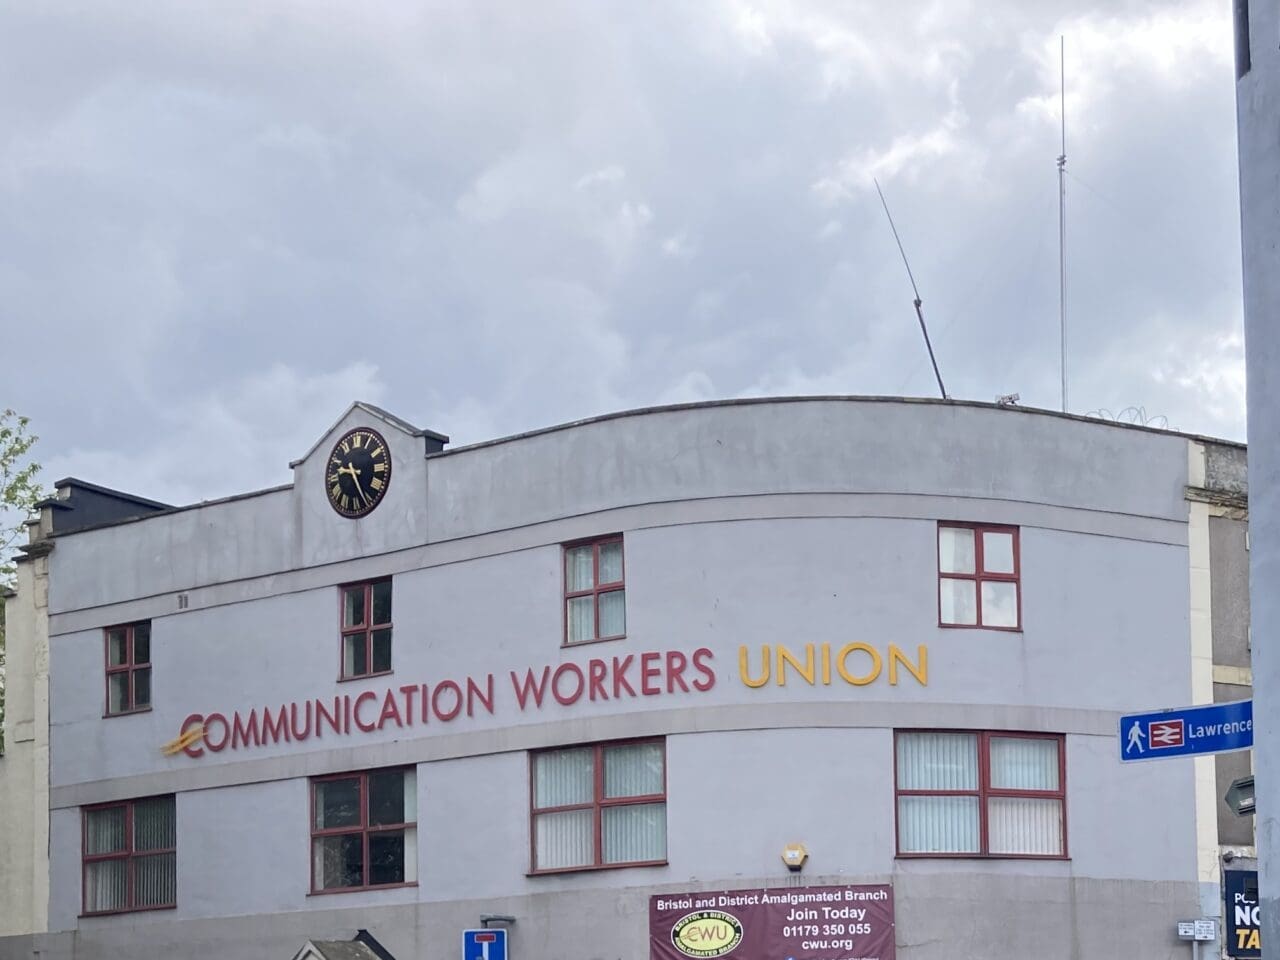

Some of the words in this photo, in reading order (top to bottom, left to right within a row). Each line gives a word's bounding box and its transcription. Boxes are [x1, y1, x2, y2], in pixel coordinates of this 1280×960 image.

[180, 673, 496, 758] COMMUNICATION
[510, 647, 716, 714] WORKERS
[738, 642, 929, 689] UNION
[1188, 718, 1253, 739] Lawrence
[657, 898, 692, 910] Bristol
[695, 897, 715, 908] and
[719, 895, 758, 906] District
[761, 891, 841, 905] Amalgamated
[845, 890, 887, 901] Branch
[787, 908, 818, 920] Join
[822, 906, 866, 921] Today
[783, 925, 819, 937] 01179
[822, 924, 845, 935] 350
[848, 923, 871, 934] 055
[802, 939, 853, 950] cwu.org
